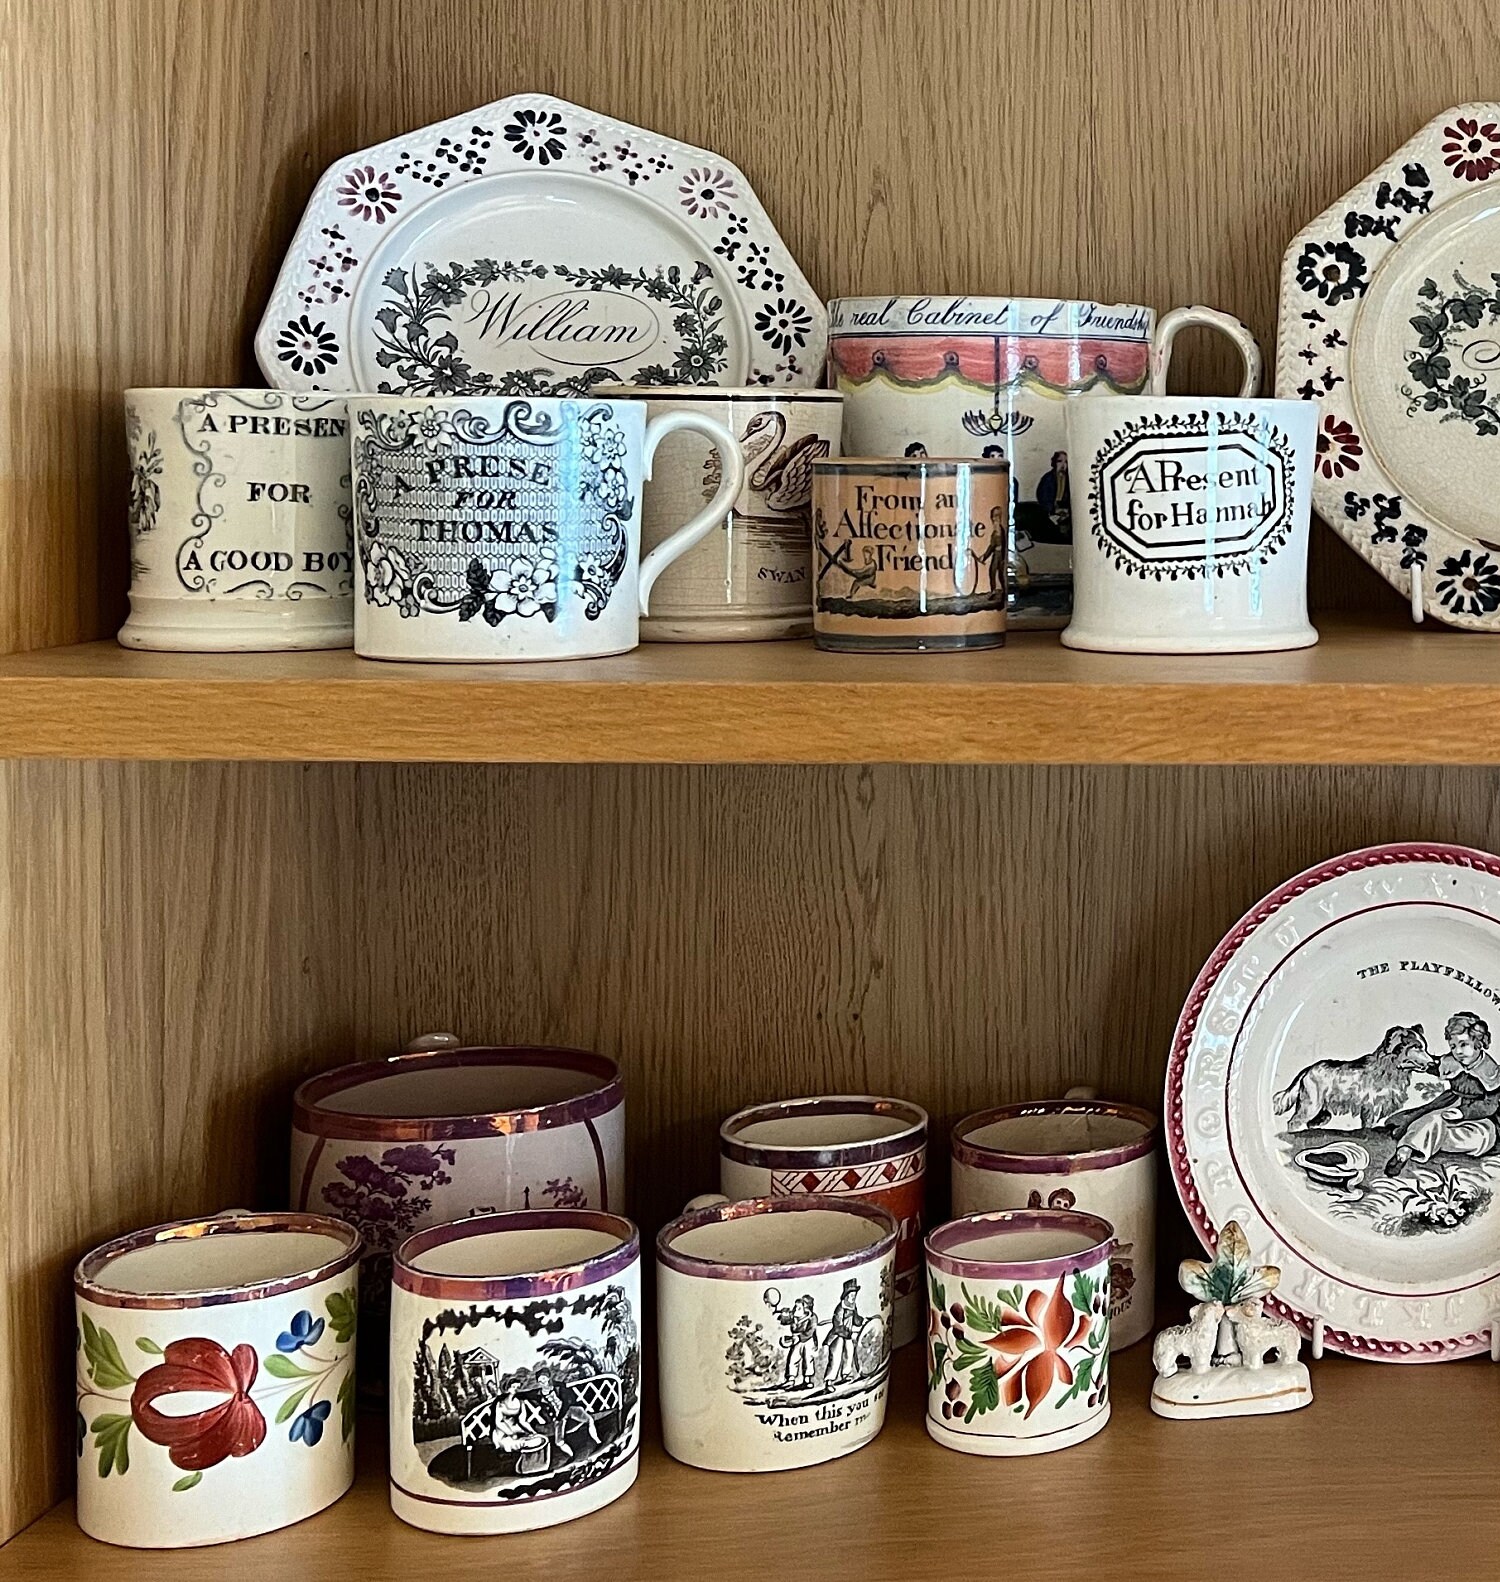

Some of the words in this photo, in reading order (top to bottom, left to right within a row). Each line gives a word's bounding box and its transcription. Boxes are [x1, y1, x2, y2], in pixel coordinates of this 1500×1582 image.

[465, 289, 655, 350] William
[850, 299, 897, 325] real
[907, 298, 1010, 325] Cabinet
[1031, 302, 1066, 334] of
[197, 413, 219, 432] A
[228, 415, 346, 437] PRESEN
[393, 474, 415, 499] A
[1123, 462, 1156, 493] A
[1155, 460, 1260, 492] Present
[246, 482, 312, 503] FOR
[453, 490, 517, 510] FOR
[855, 485, 922, 511] From
[1127, 499, 1167, 531] for
[1171, 493, 1273, 527] Hannah
[410, 519, 560, 543] THOMAS
[183, 550, 203, 571] A
[210, 549, 293, 572] GOOD
[302, 552, 354, 573] BOY
[876, 543, 953, 571] Friend
[758, 567, 806, 583] SWAN
[1356, 962, 1390, 980] THE
[754, 1413, 809, 1427] When
[815, 1404, 843, 1421] this
[847, 1398, 869, 1417] you
[773, 1420, 851, 1442] Remember
